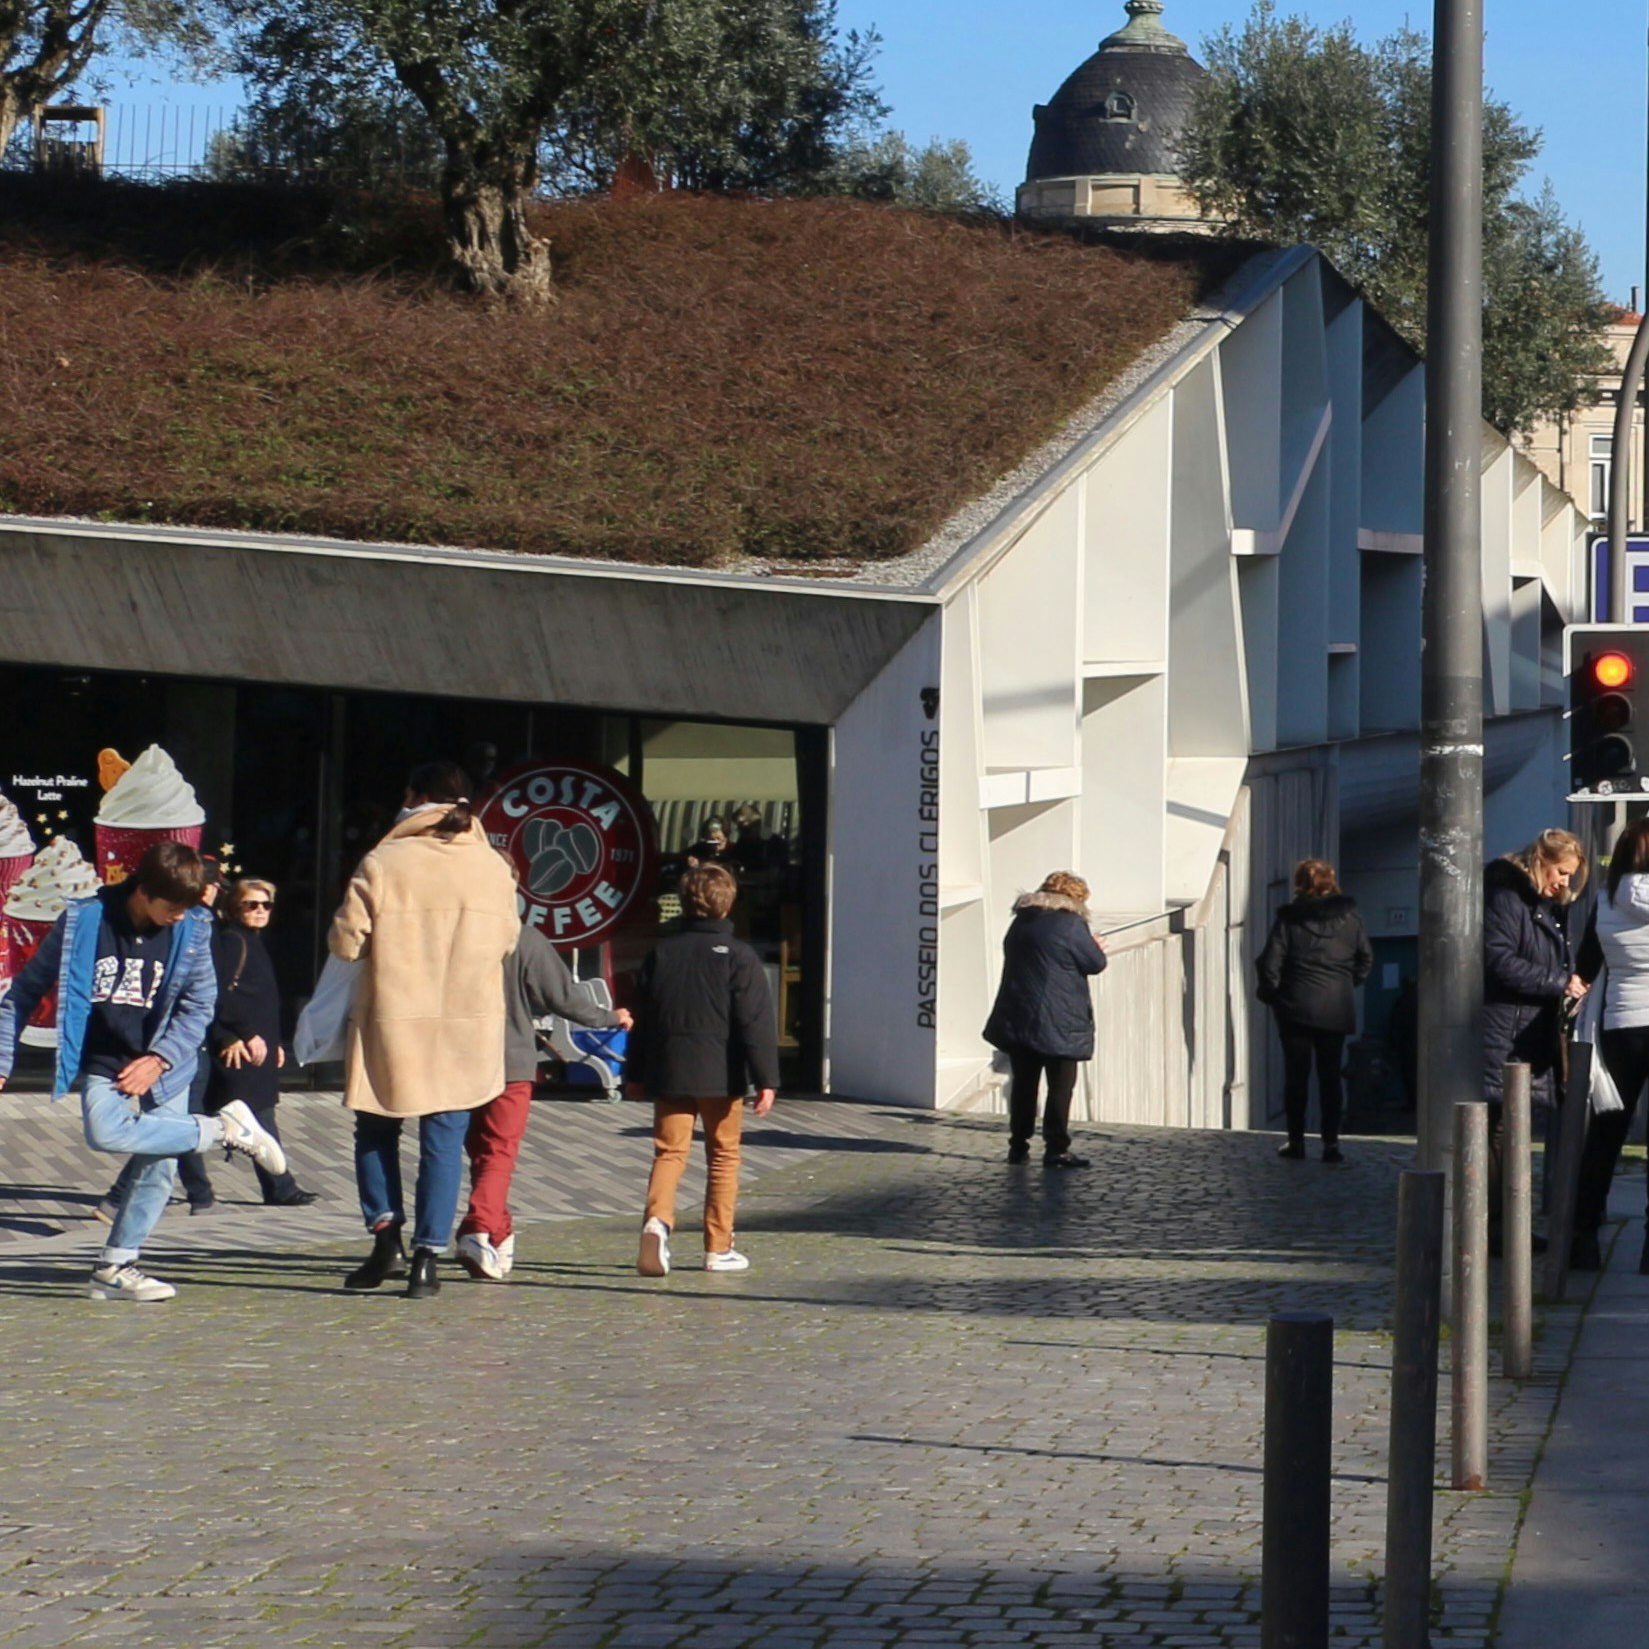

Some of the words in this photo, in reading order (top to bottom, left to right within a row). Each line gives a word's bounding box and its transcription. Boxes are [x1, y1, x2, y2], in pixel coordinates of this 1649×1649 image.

[12, 775, 54, 787] Hazelnut
[55, 775, 88, 787] Praline
[37, 790, 62, 801] Latte
[502, 776, 621, 831] COSTA
[919, 730, 939, 853] CLÉRIGOS
[516, 880, 624, 935] FFEE
[919, 863, 938, 916] DOS
[917, 927, 938, 1030] PASSEIO
